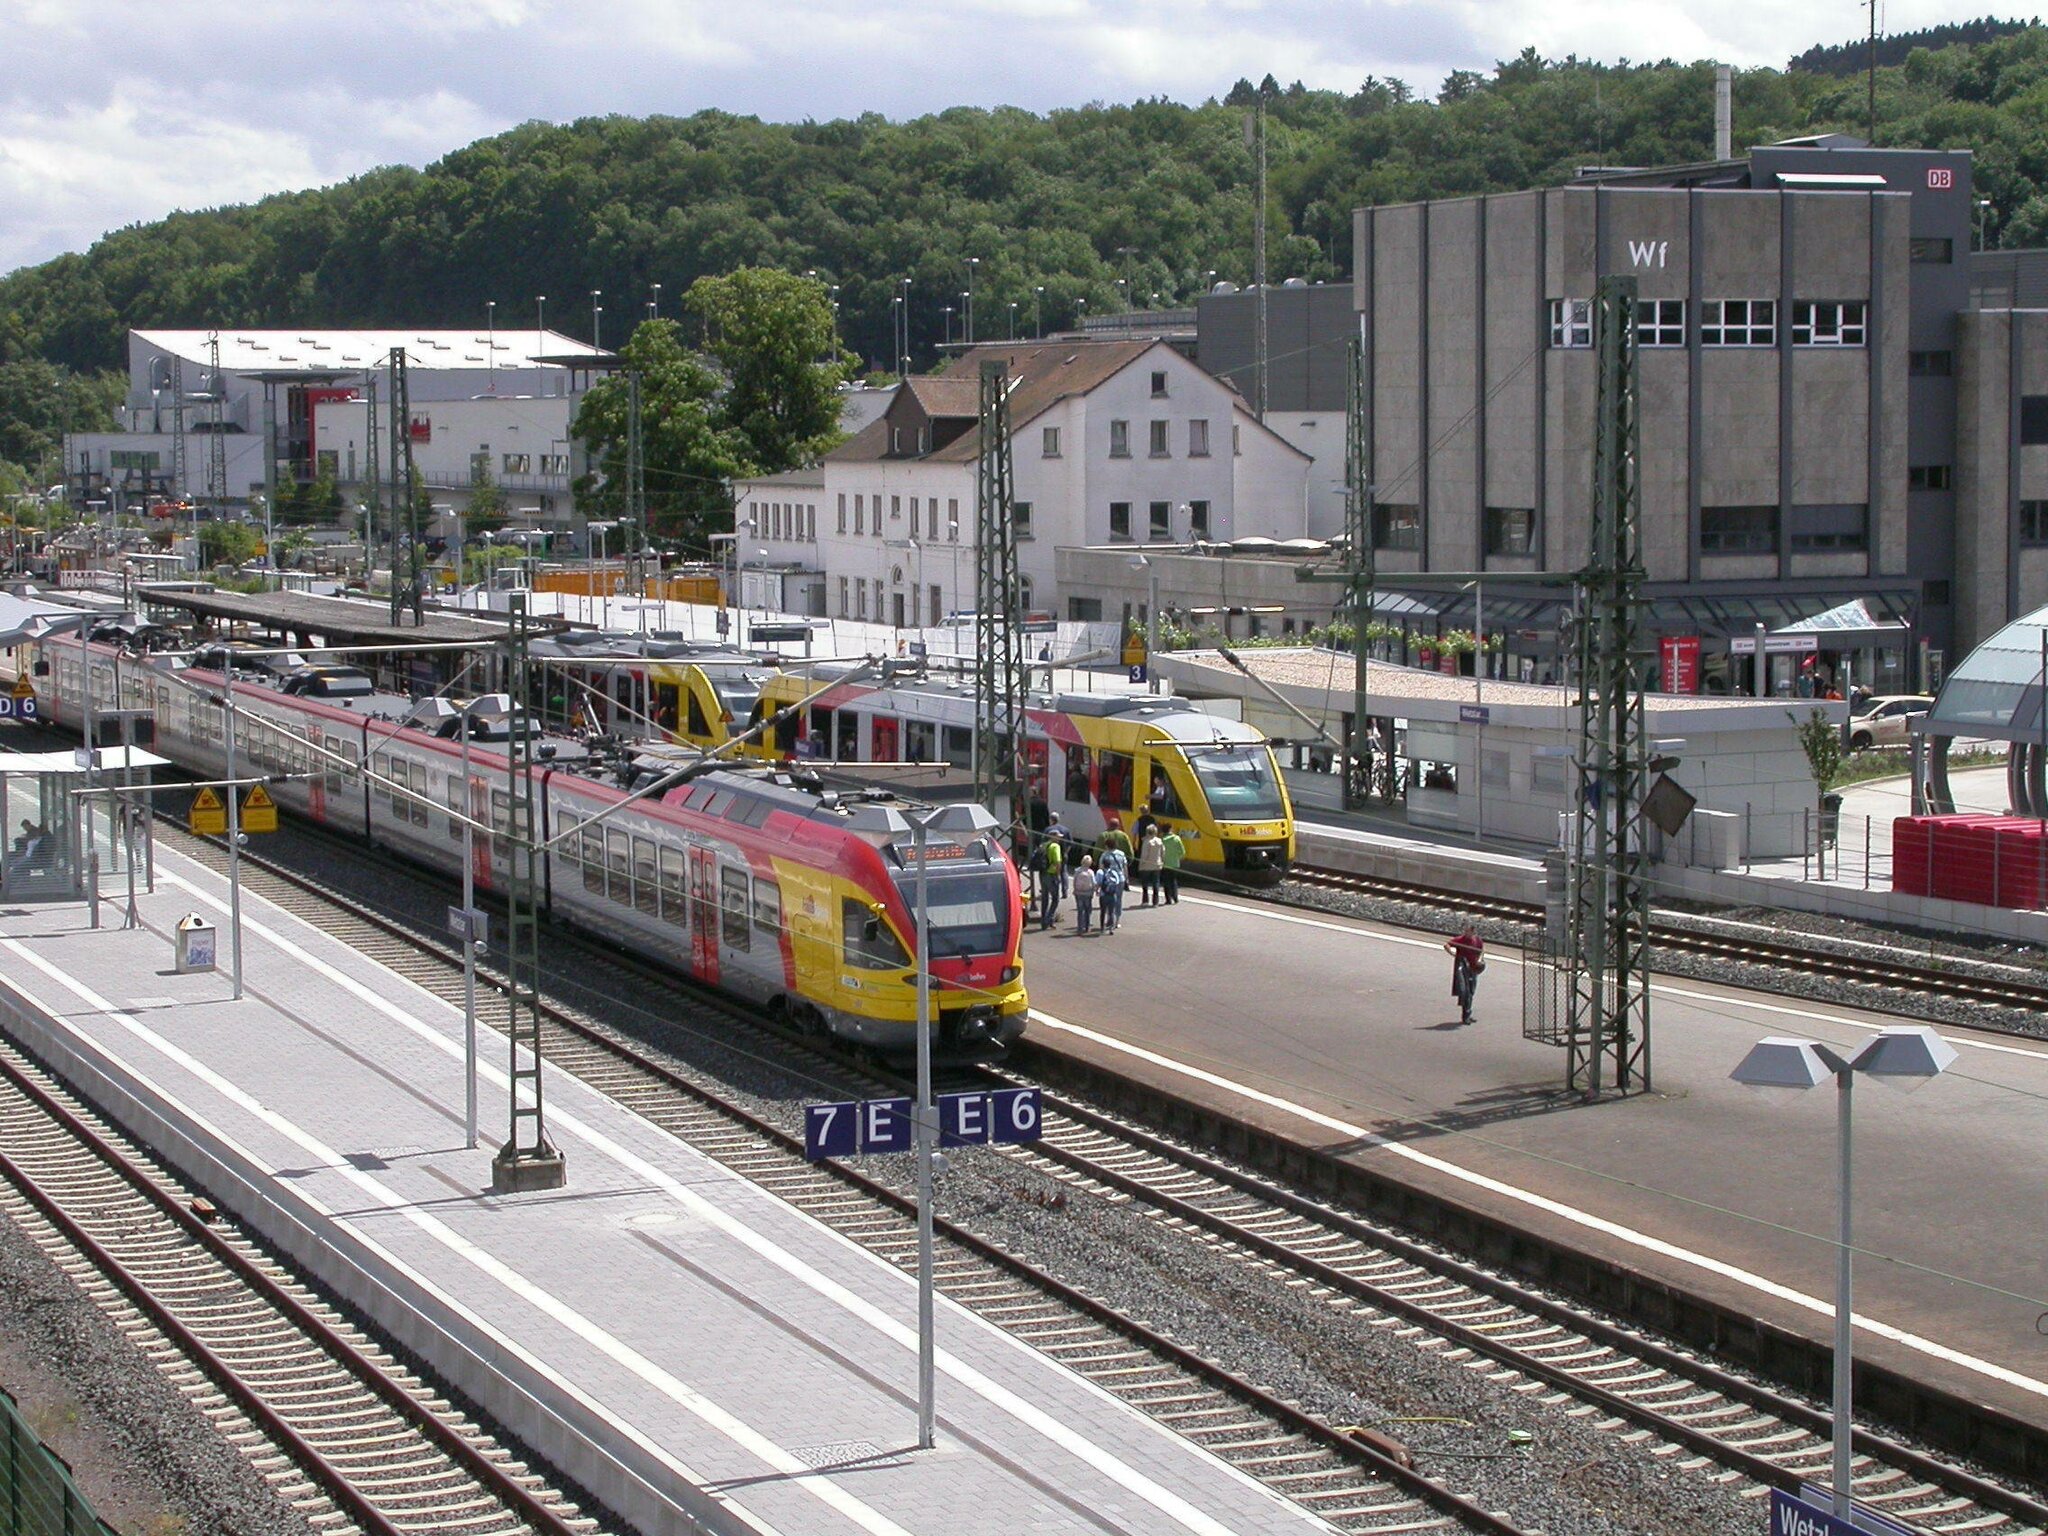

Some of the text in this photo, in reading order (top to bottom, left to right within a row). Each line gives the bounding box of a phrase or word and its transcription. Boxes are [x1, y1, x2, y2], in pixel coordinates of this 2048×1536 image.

[1929, 170, 1950, 187] DB
[1628, 240, 1668, 268] Wf
[1131, 665, 1141, 680] 3
[23, 697, 35, 713] 6
[957, 1091, 1036, 1135] E 6
[813, 1103, 893, 1146] 7 E
